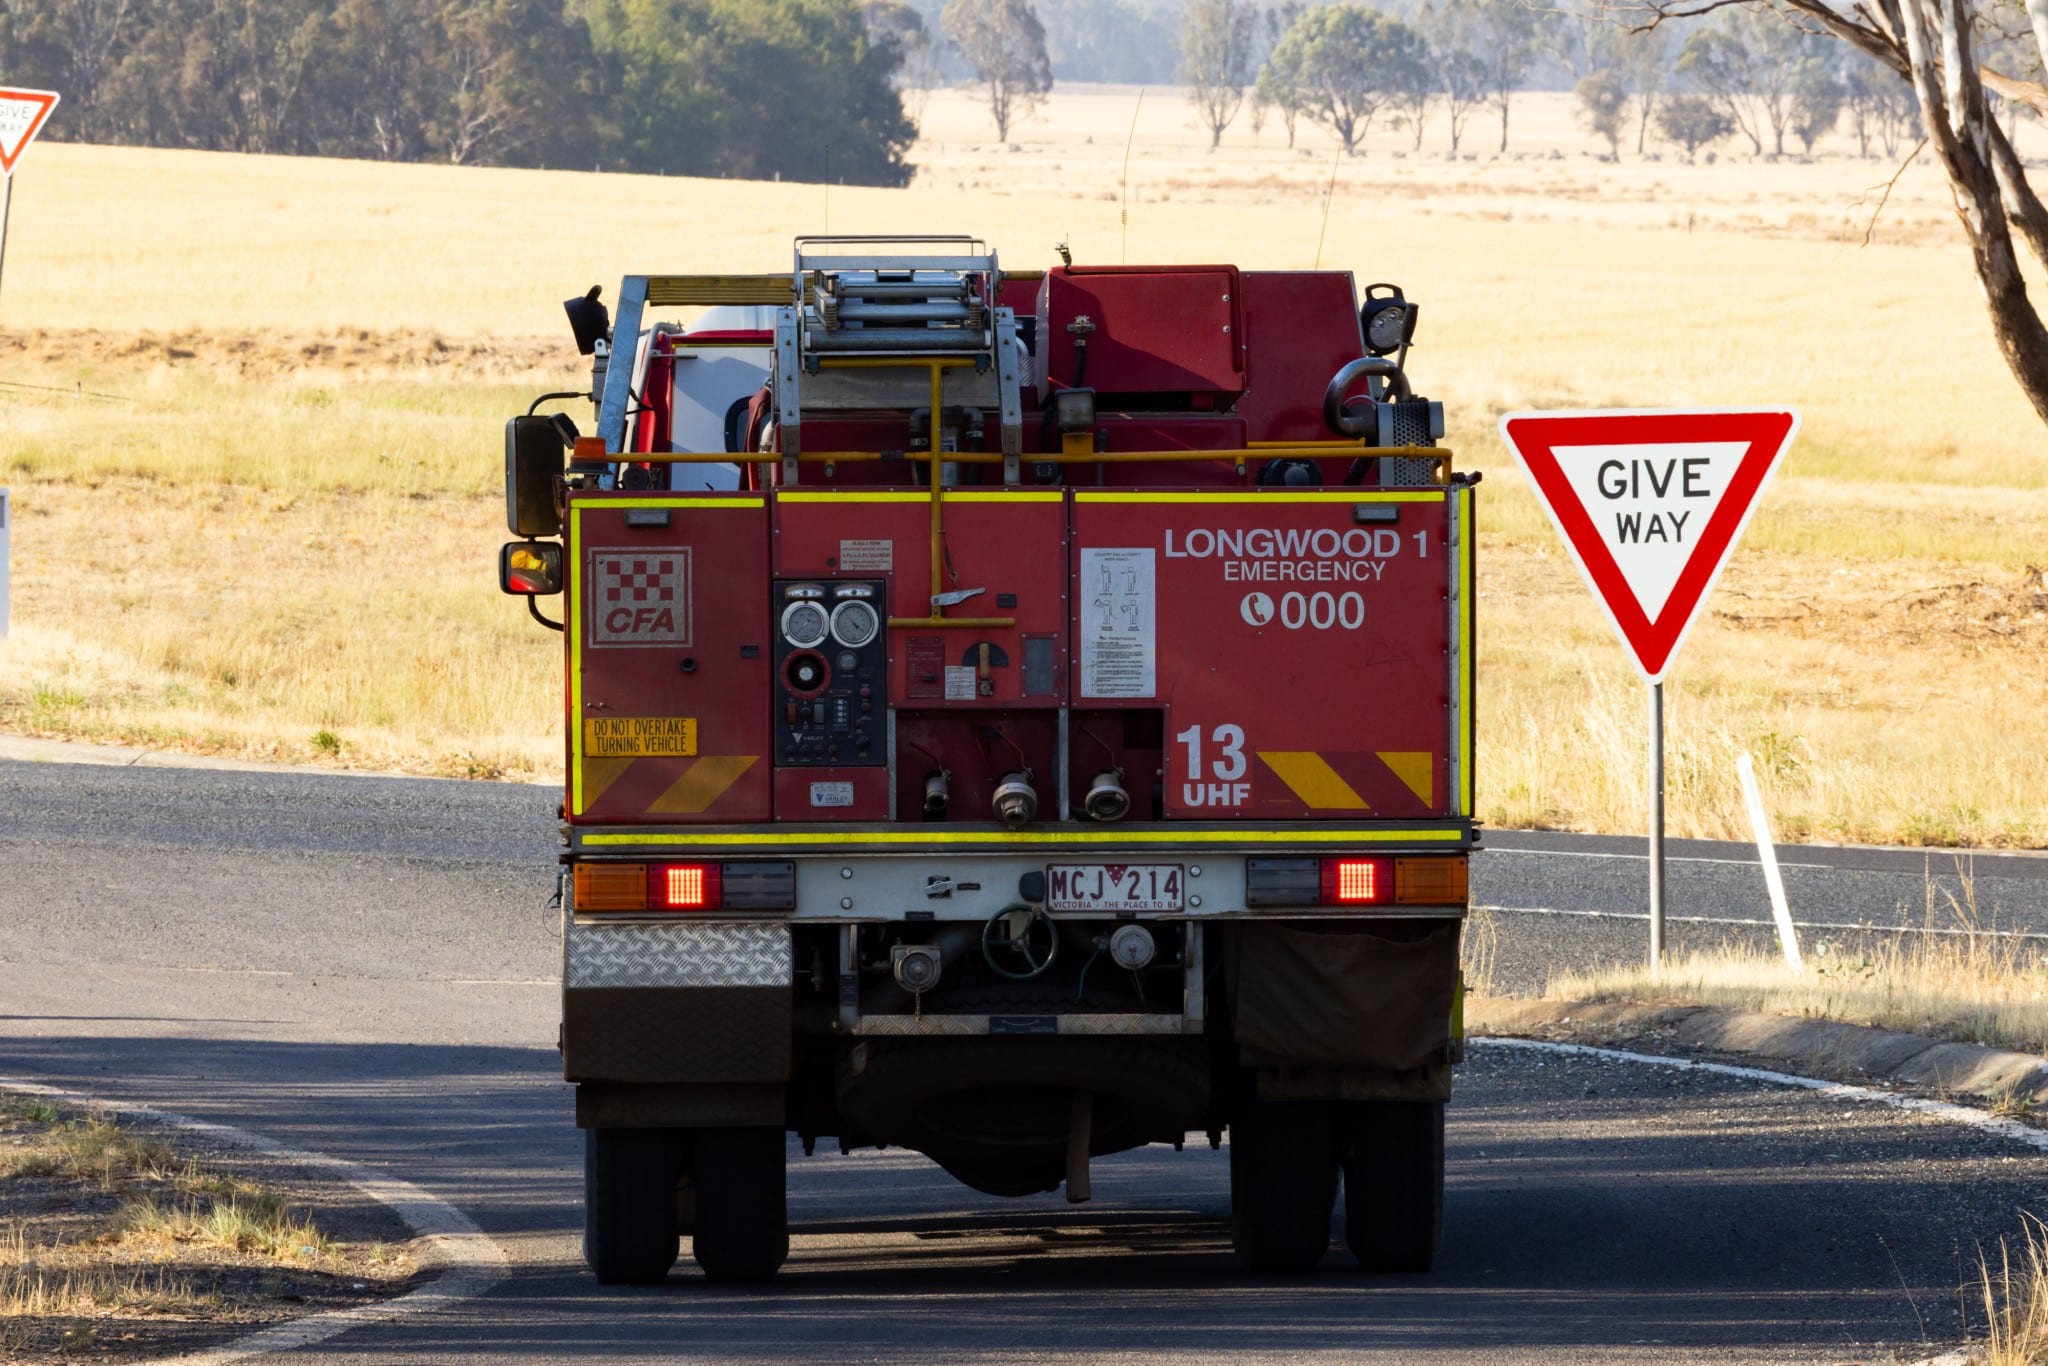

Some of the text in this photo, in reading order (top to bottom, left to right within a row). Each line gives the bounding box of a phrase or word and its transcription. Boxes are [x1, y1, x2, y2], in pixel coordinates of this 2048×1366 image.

[1598, 458, 1710, 500] GIVE
[1616, 510, 1691, 544] WAY
[1165, 529, 1427, 557] LONGWOOD 1
[1224, 561, 1386, 581] EMERGENCY
[605, 607, 675, 633] CFA
[1280, 591, 1365, 629] 000
[594, 719, 687, 735] DO NOT OVERTAKE
[596, 736, 686, 752] TURNING VEHICLE
[1177, 723, 1247, 780] 13
[1183, 783, 1251, 806] UHF
[1052, 870, 1179, 900] MCJ 214
[1054, 901, 1091, 909] VICTORIA
[1104, 901, 1119, 909] THE
[1124, 901, 1148, 909] PLACE
[1153, 901, 1163, 909] TO
[1168, 901, 1178, 909] BE
